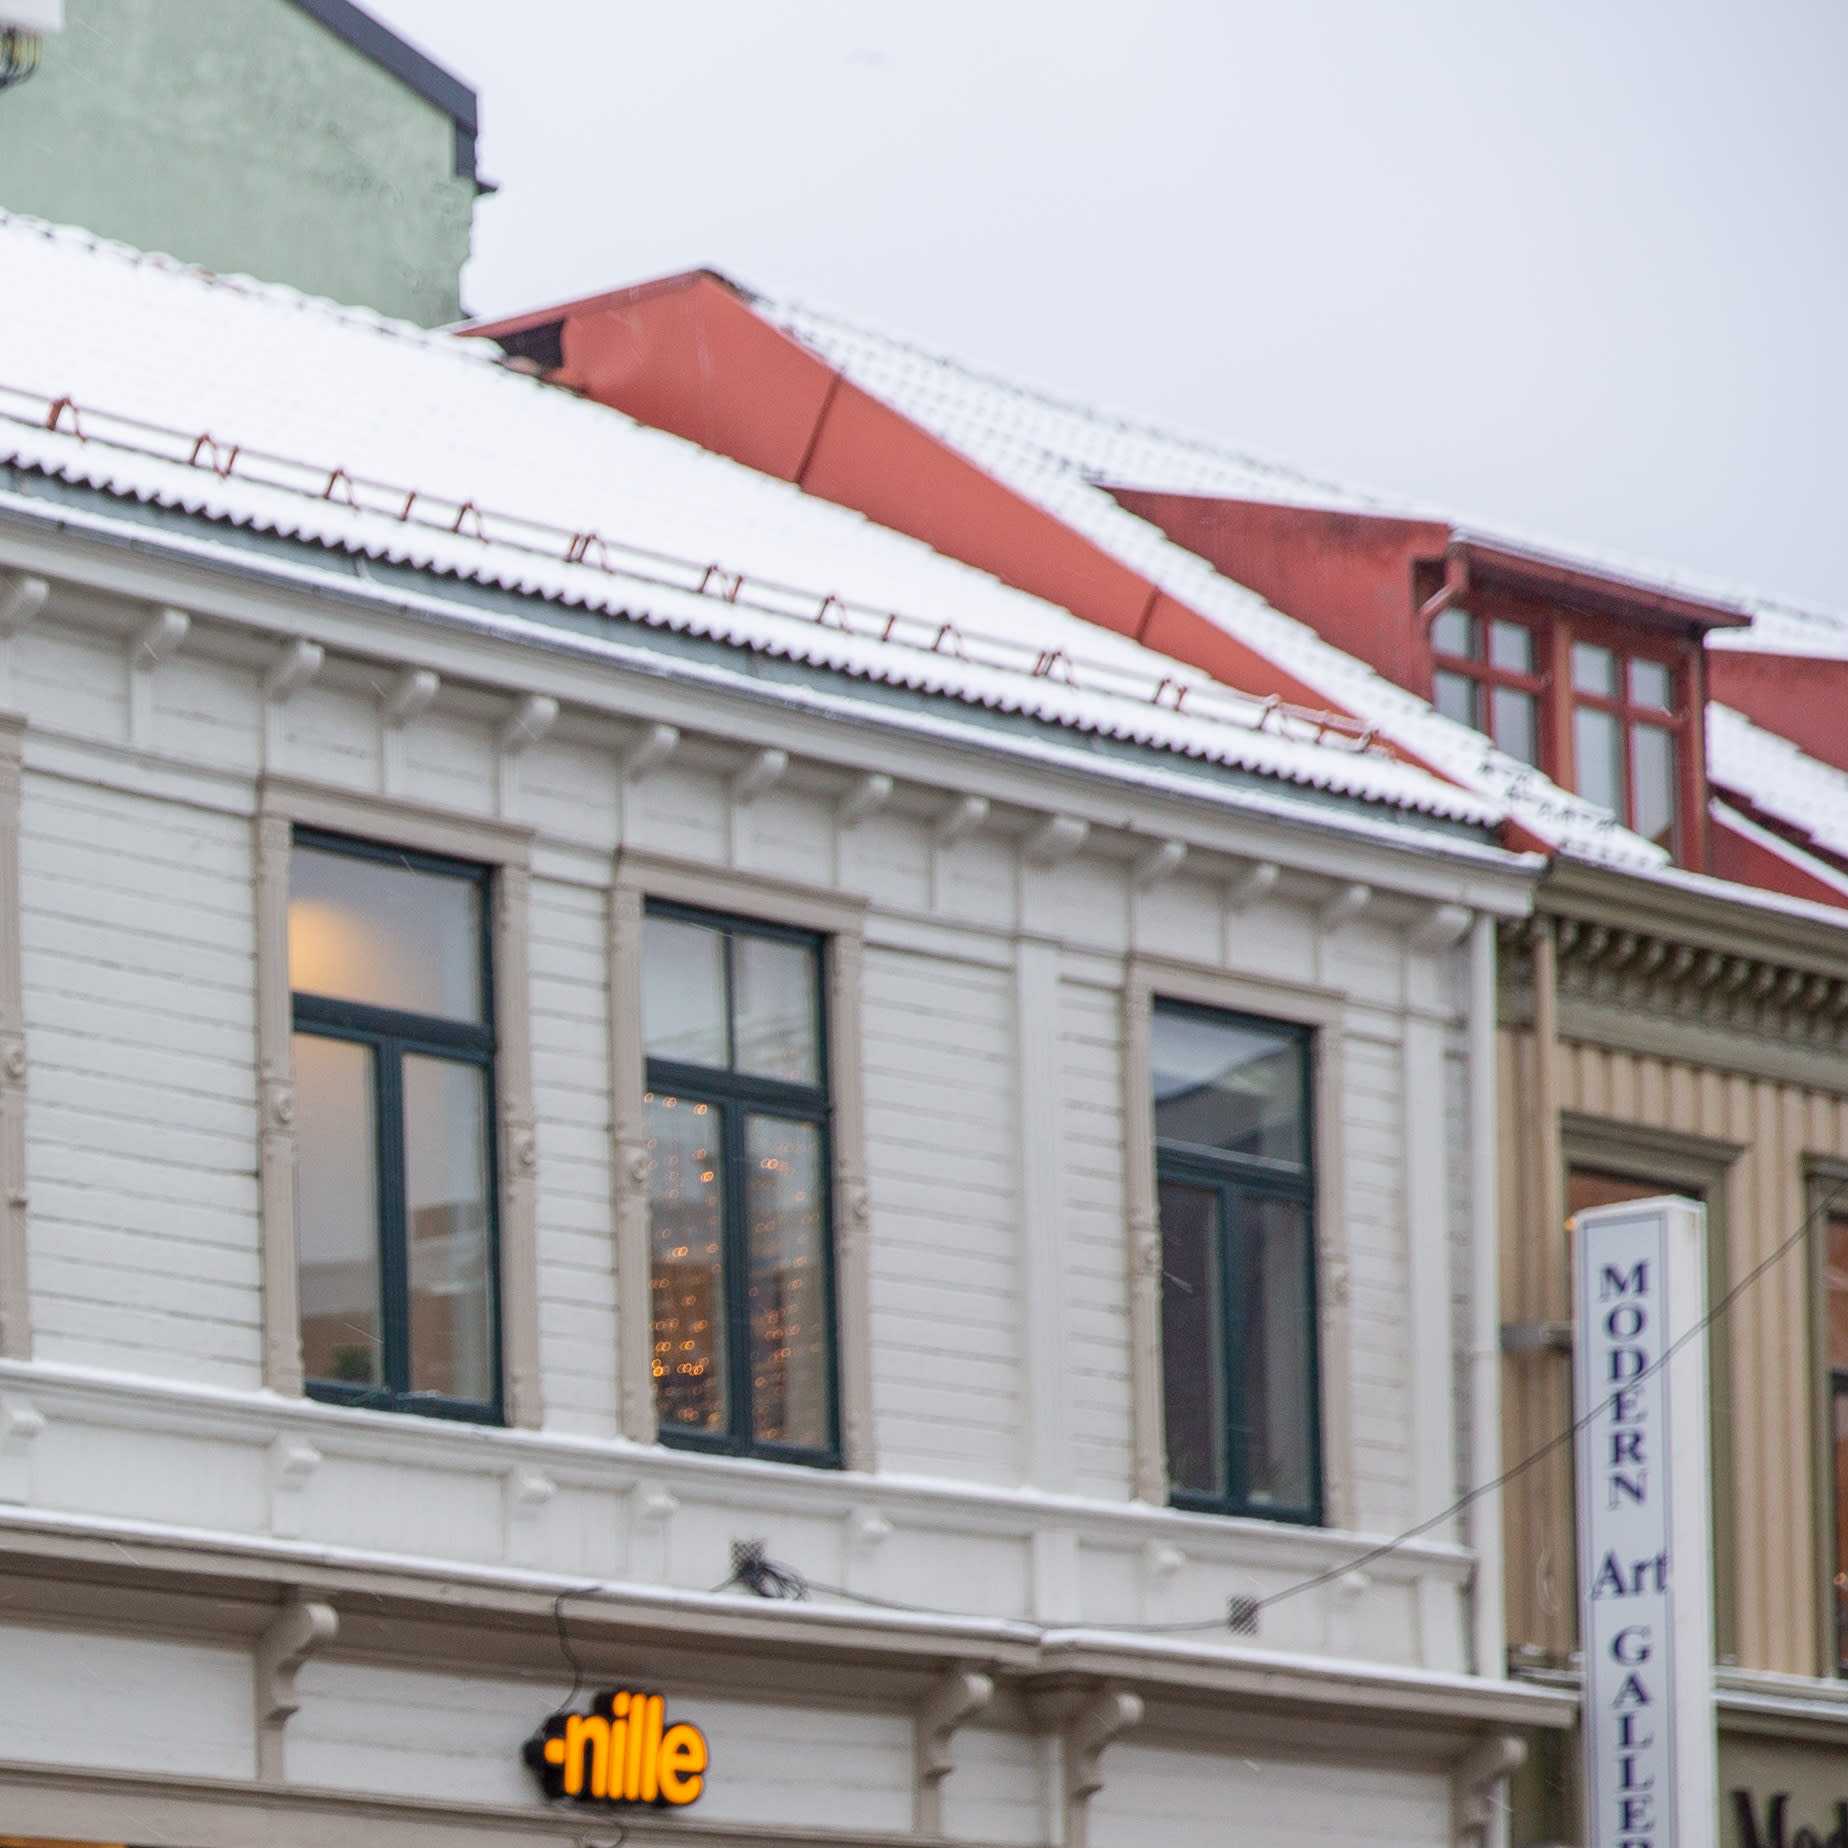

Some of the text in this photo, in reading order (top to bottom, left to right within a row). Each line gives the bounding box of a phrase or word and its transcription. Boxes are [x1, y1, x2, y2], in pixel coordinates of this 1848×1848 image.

[1597, 1257, 1652, 1511] MODERN
[1590, 1546, 1668, 1601] Art
[563, 1690, 708, 1805] nille
